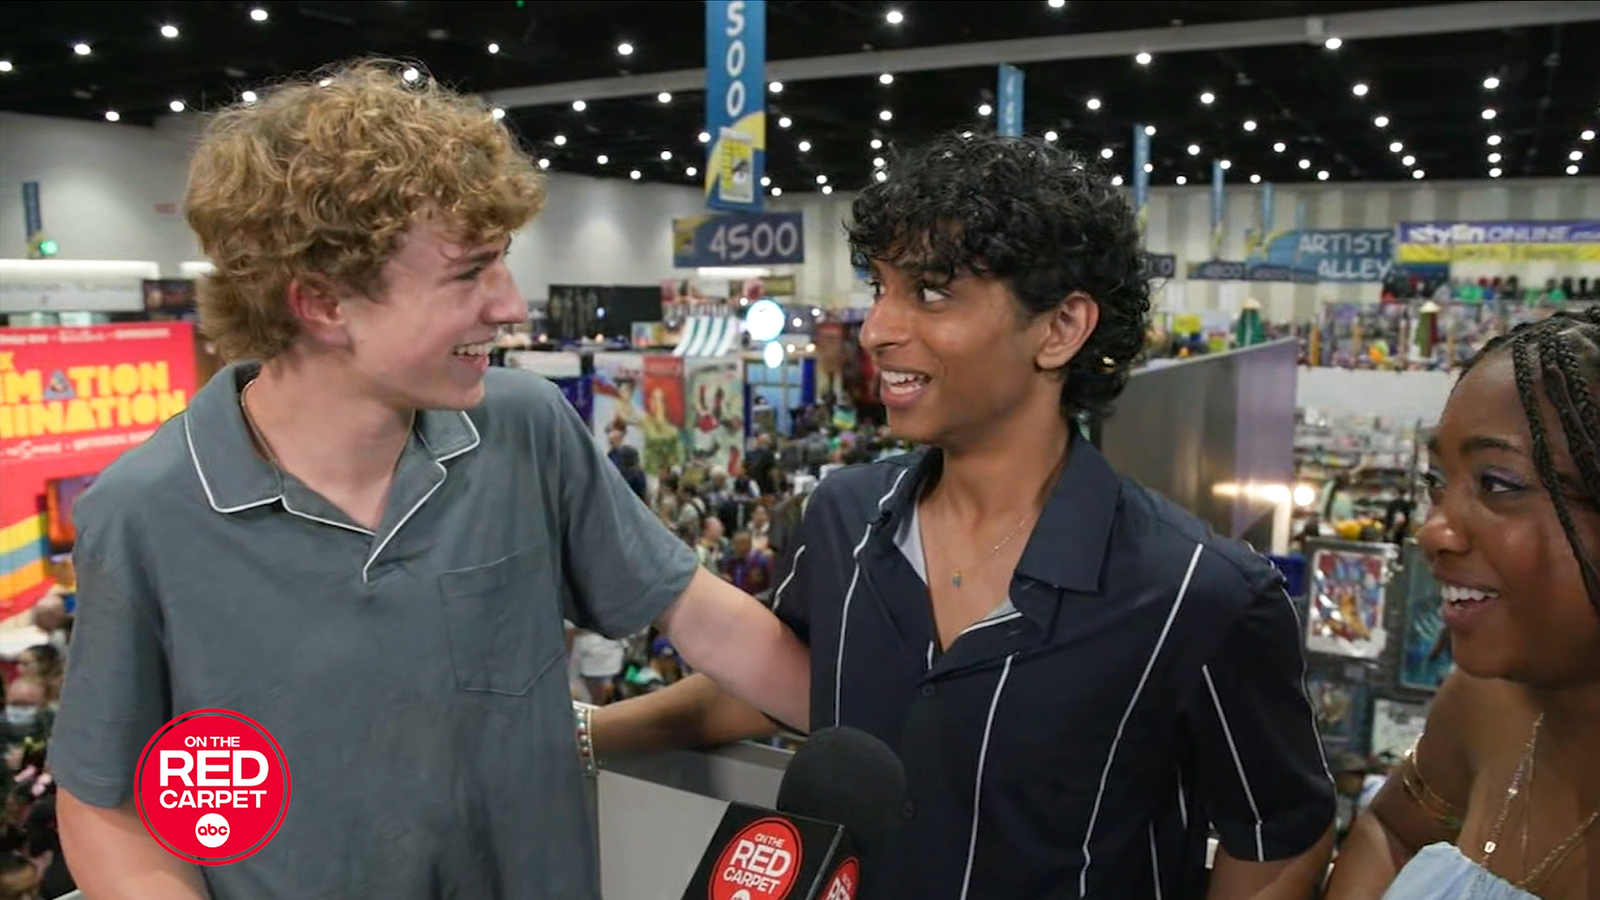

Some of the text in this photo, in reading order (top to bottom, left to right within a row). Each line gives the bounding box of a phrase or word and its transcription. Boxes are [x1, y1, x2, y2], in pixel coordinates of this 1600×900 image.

[709, 221, 798, 259] 4500
[1318, 257, 1393, 279] ALLEY
[754, 833, 785, 848] ON THE
[730, 839, 791, 878] RED
[723, 866, 781, 895] CARPET
